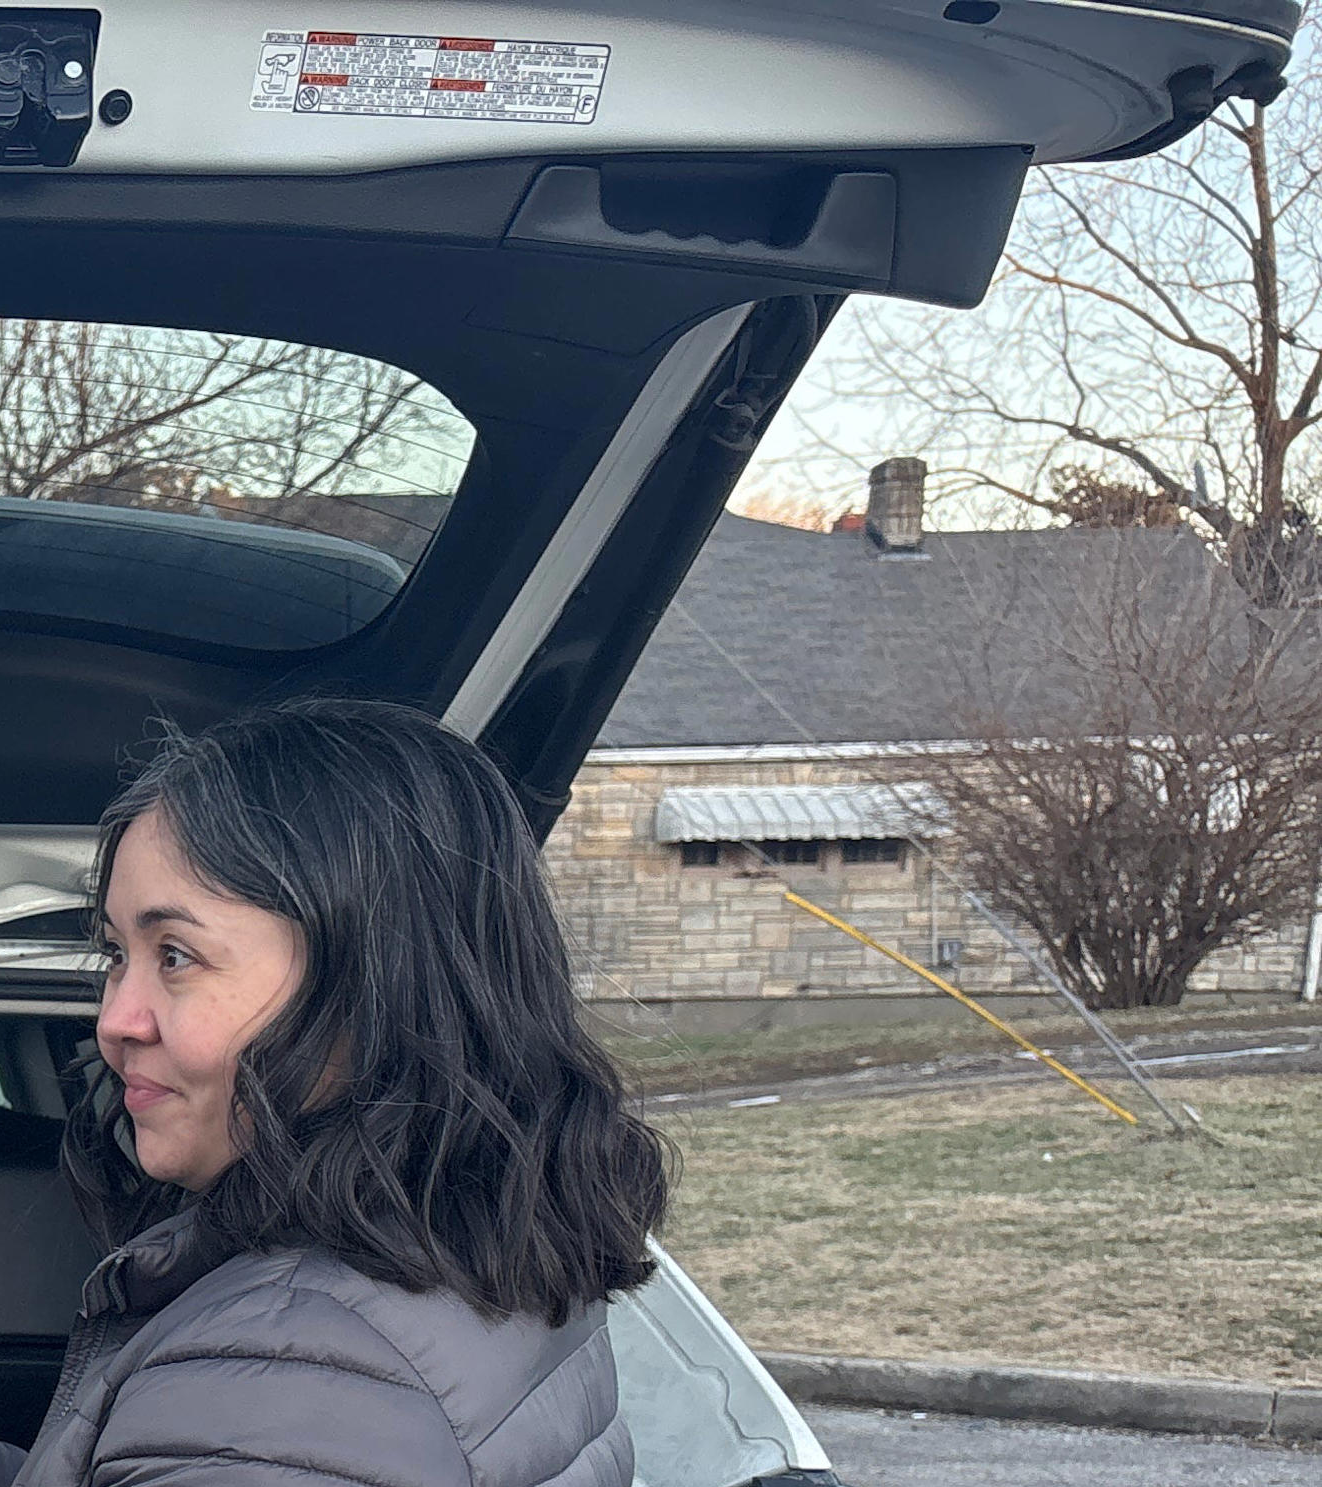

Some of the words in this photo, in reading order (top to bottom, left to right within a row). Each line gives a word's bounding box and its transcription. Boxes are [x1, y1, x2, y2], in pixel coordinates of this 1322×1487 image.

[358, 37, 385, 46] POWER
[389, 38, 411, 46] BACK
[414, 38, 437, 47] DOOR
[310, 76, 348, 86] WARNING
[350, 77, 369, 86] BACK
[373, 78, 396, 87] DOOR
[399, 79, 428, 88] CLOSER
